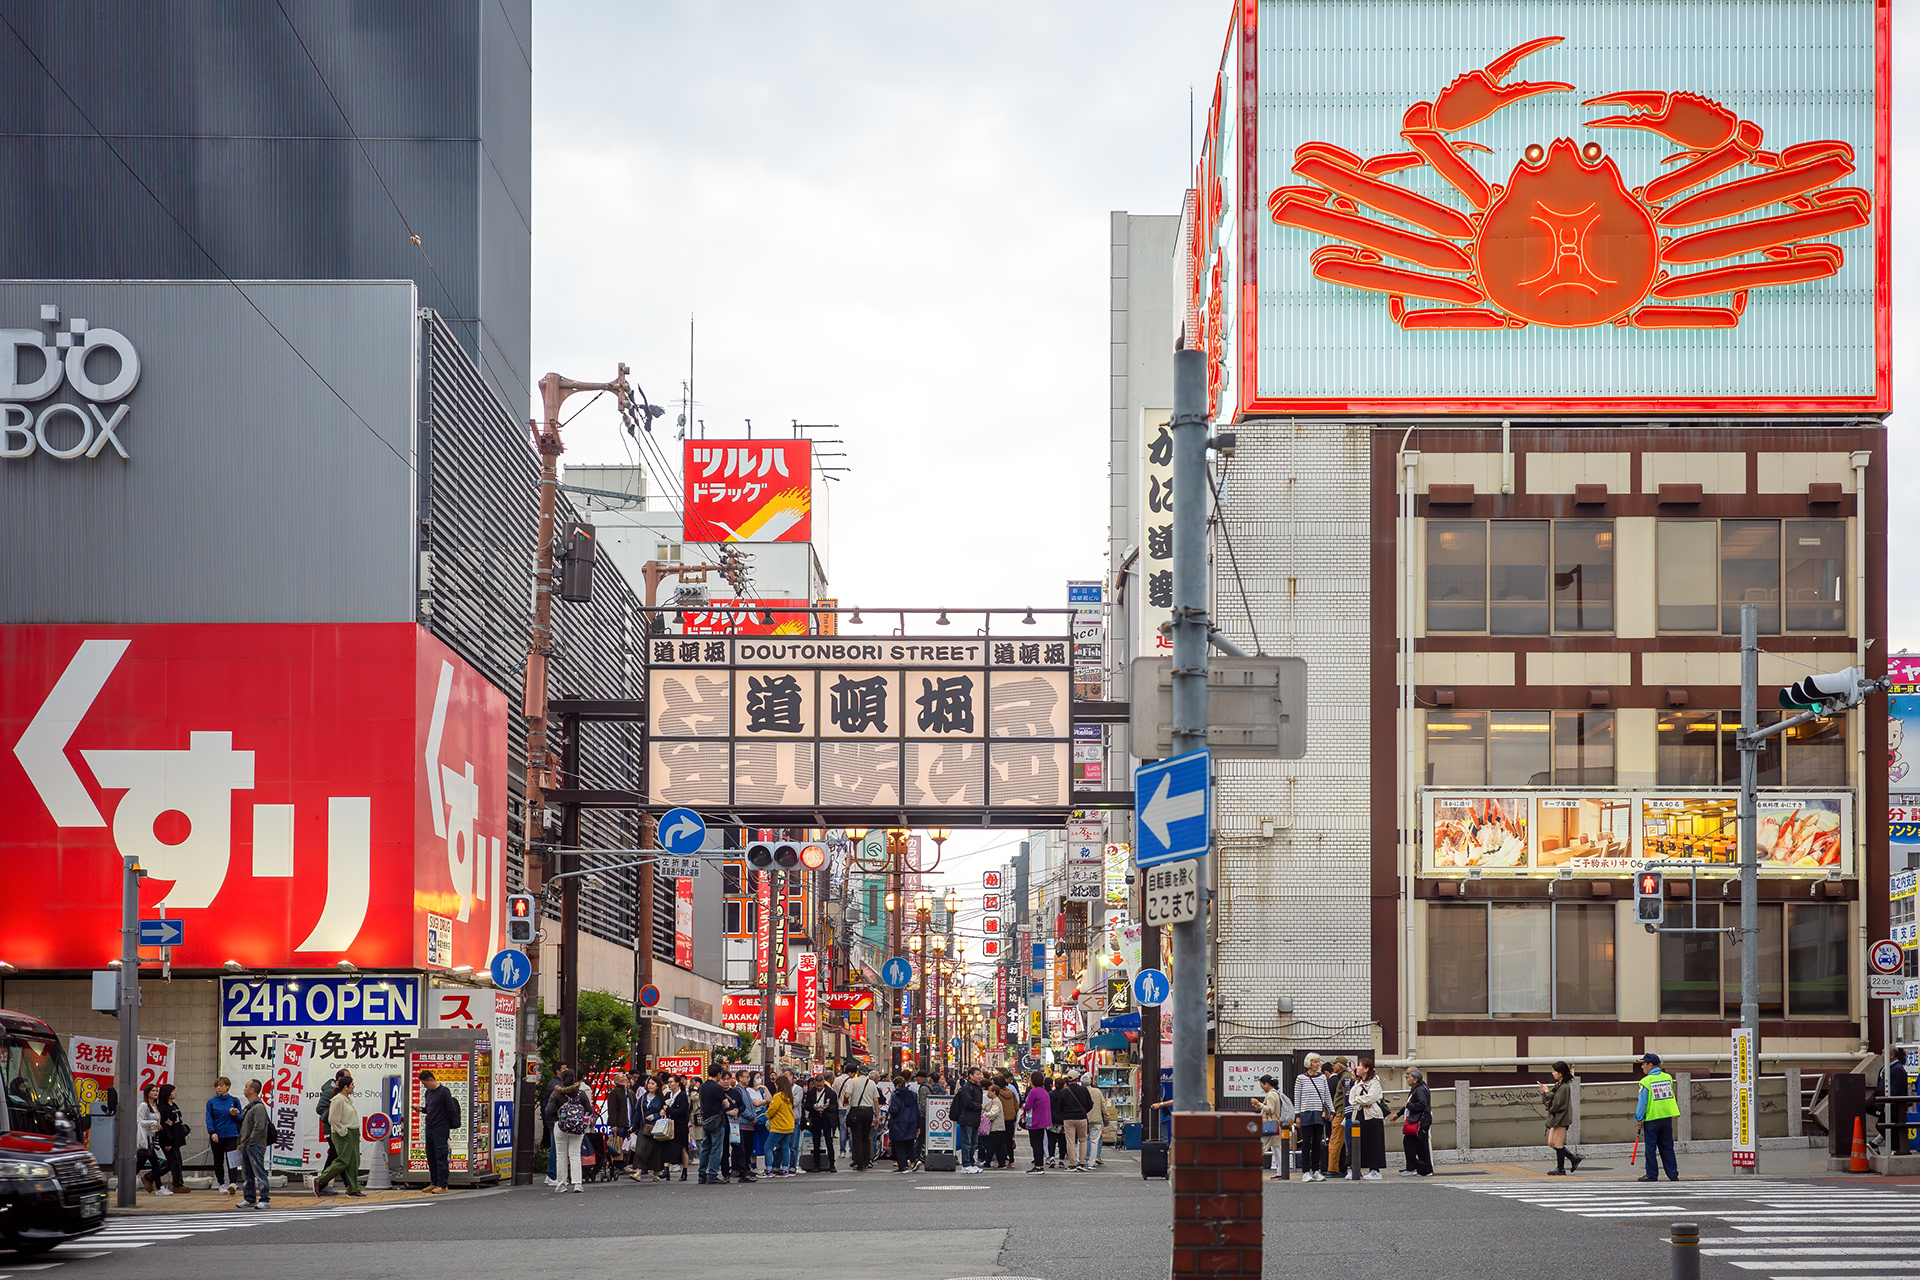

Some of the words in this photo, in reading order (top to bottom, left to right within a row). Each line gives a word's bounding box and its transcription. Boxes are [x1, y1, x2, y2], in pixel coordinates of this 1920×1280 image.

[0, 403, 131, 459] BOX
[693, 448, 790, 478] ツルハ
[693, 482, 768, 503] ドラッグ
[653, 640, 727, 663] 道頓堀
[740, 644, 883, 661] DOUTONBORI
[890, 645, 979, 661] STREET
[994, 642, 1066, 665] 道頓堀
[746, 674, 975, 734] 道頓堀
[13, 639, 371, 953] くすり
[425, 659, 501, 971] くすり
[661, 858, 699, 868] 左折禁止
[1572, 858, 1628, 869] ご予約承り中
[1149, 868, 1194, 892] 自転車を除く
[1148, 891, 1195, 920] ここまで
[800, 955, 815, 970] 薬
[228, 983, 297, 1022] 24h
[306, 983, 413, 1022] OPEN
[803, 975, 816, 1021] アカカベ
[1082, 996, 1106, 1010] くす
[75, 1042, 114, 1064] 免税
[75, 1062, 90, 1071] Tax
[92, 1064, 111, 1074] Free
[343, 1062, 359, 1071] shop
[368, 1062, 383, 1071] duty
[1228, 1065, 1280, 1074] 自転車・バイクの
[140, 1068, 169, 1092] 24
[276, 1068, 304, 1094] 24
[1228, 1084, 1255, 1092] 禁止です
[278, 1094, 300, 1106] 時間
[274, 1107, 298, 1151] 営業
[496, 1128, 511, 1145] OPEN
